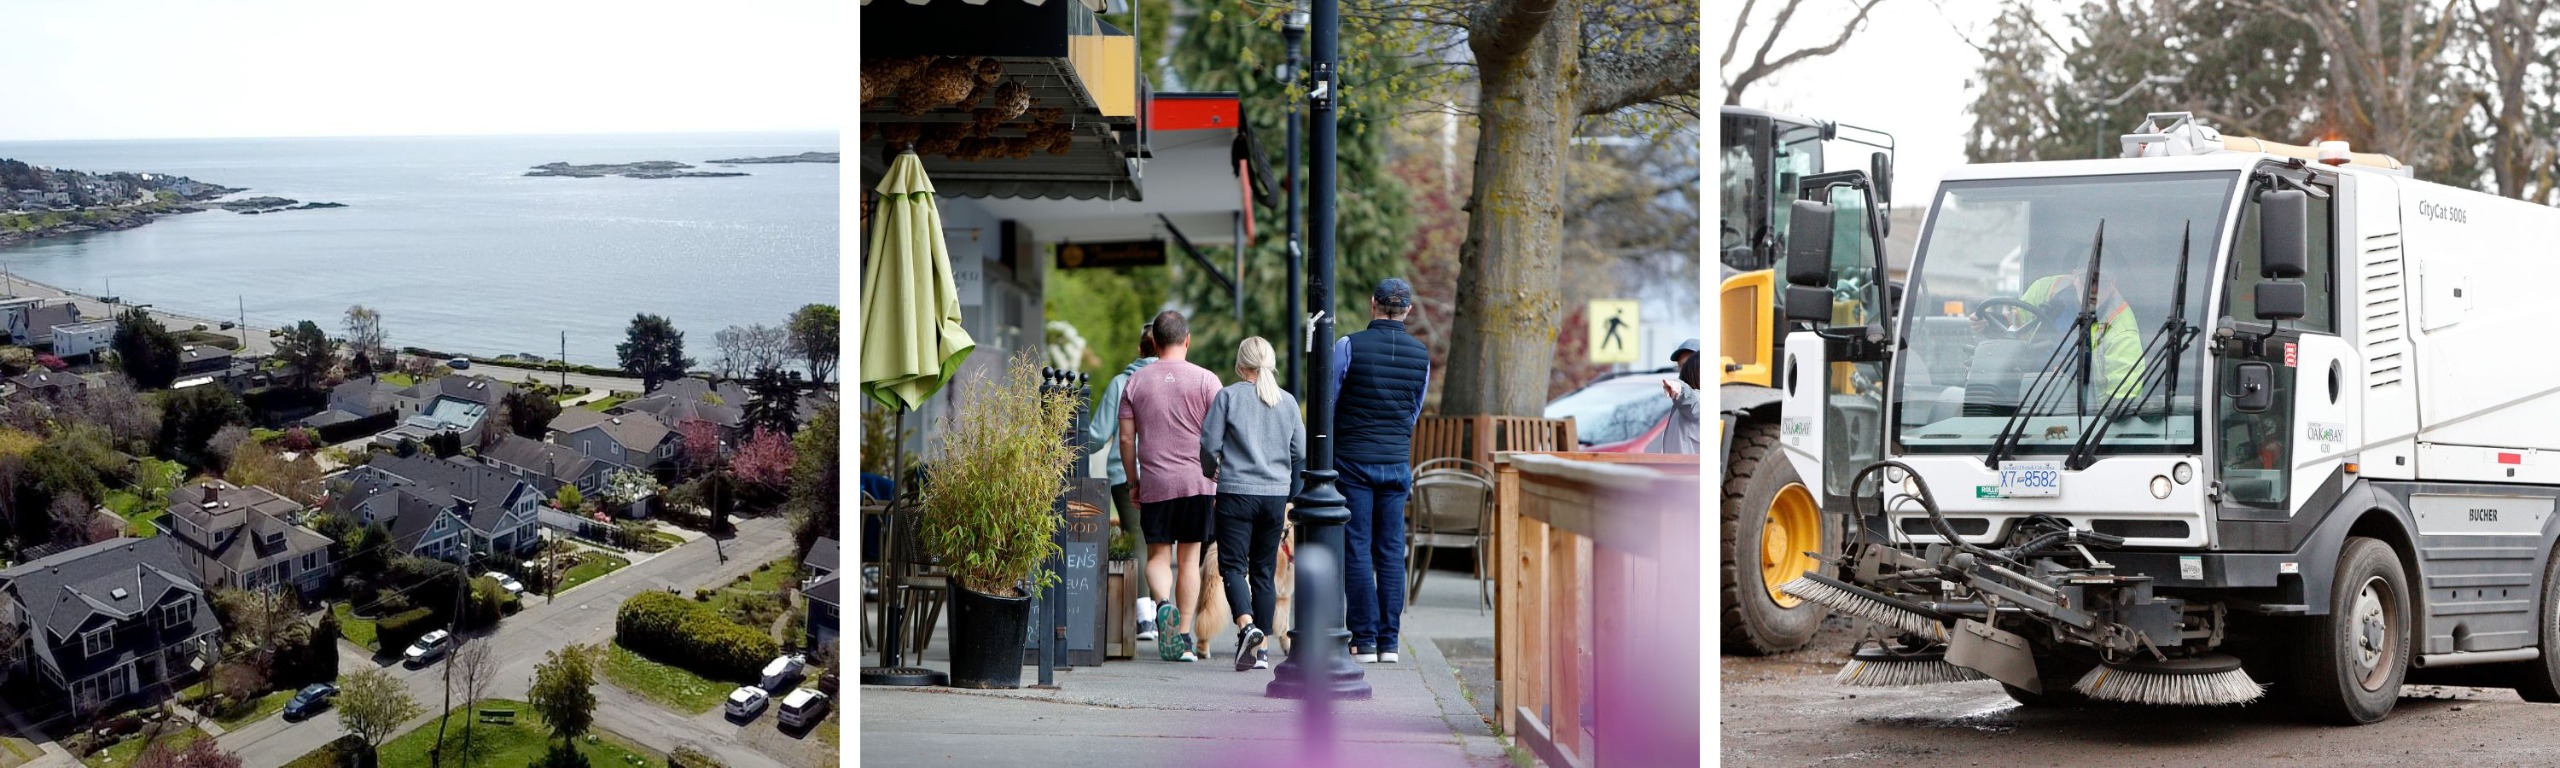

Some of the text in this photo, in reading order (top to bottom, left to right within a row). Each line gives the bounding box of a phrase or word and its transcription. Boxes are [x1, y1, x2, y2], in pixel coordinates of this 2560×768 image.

[2418, 199, 2467, 224] CityCat 5006
[2307, 426, 2344, 442] OAK BAY
[2024, 470, 2058, 488] 8582
[2468, 508, 2498, 522] BUCHER
